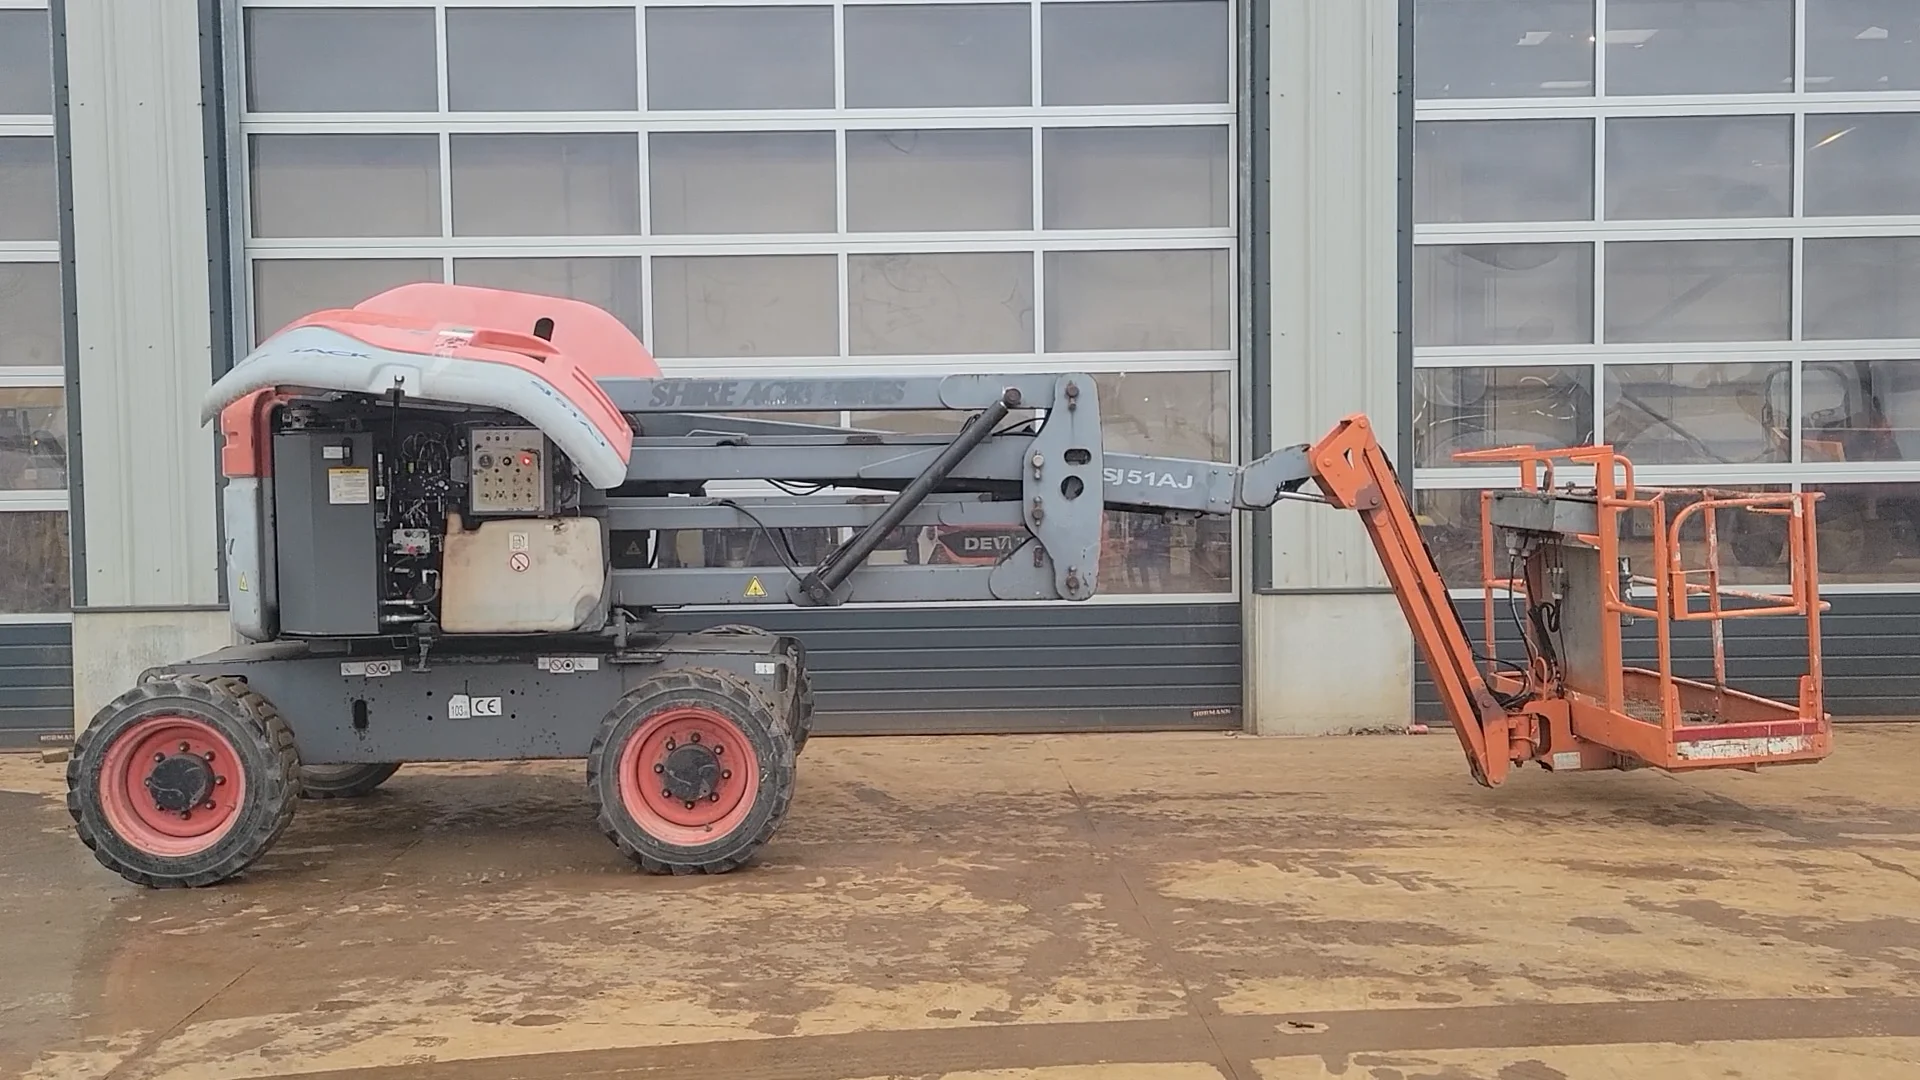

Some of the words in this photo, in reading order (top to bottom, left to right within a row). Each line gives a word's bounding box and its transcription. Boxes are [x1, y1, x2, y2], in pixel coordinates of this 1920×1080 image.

[649, 381, 739, 407] SHIRE
[1102, 466, 1194, 490] SJ51AJ
[475, 698, 497, 715] CE
